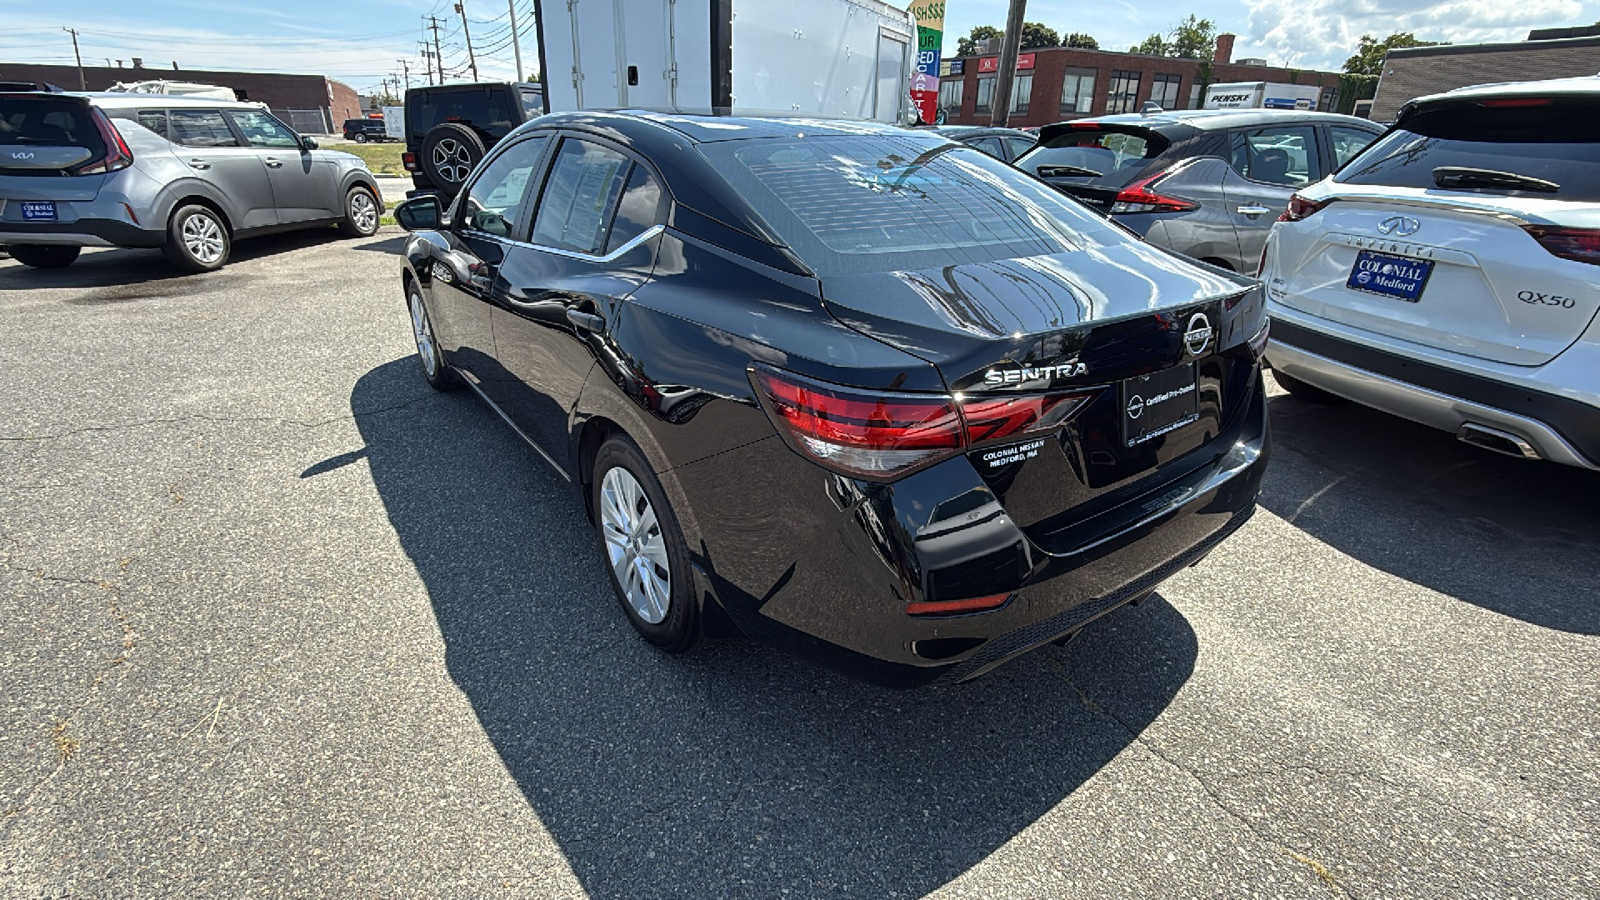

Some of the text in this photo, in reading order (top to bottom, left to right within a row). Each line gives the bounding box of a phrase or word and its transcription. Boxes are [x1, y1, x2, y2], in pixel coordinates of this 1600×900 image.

[919, 35, 935, 48] UR
[1211, 94, 1251, 103] PENSKE
[1346, 236, 1435, 258] INFINITI
[1359, 259, 1423, 281] COLONIAL
[1373, 275, 1416, 292] Medford
[1517, 290, 1576, 309] QX50
[1186, 329, 1211, 341] NISSAN
[984, 362, 1090, 386] SENTRA
[1146, 382, 1196, 406] Certified Pre-Owned
[983, 439, 1045, 461] COLONIAL NISSAN
[989, 449, 1039, 468] MEDFORD, MA
